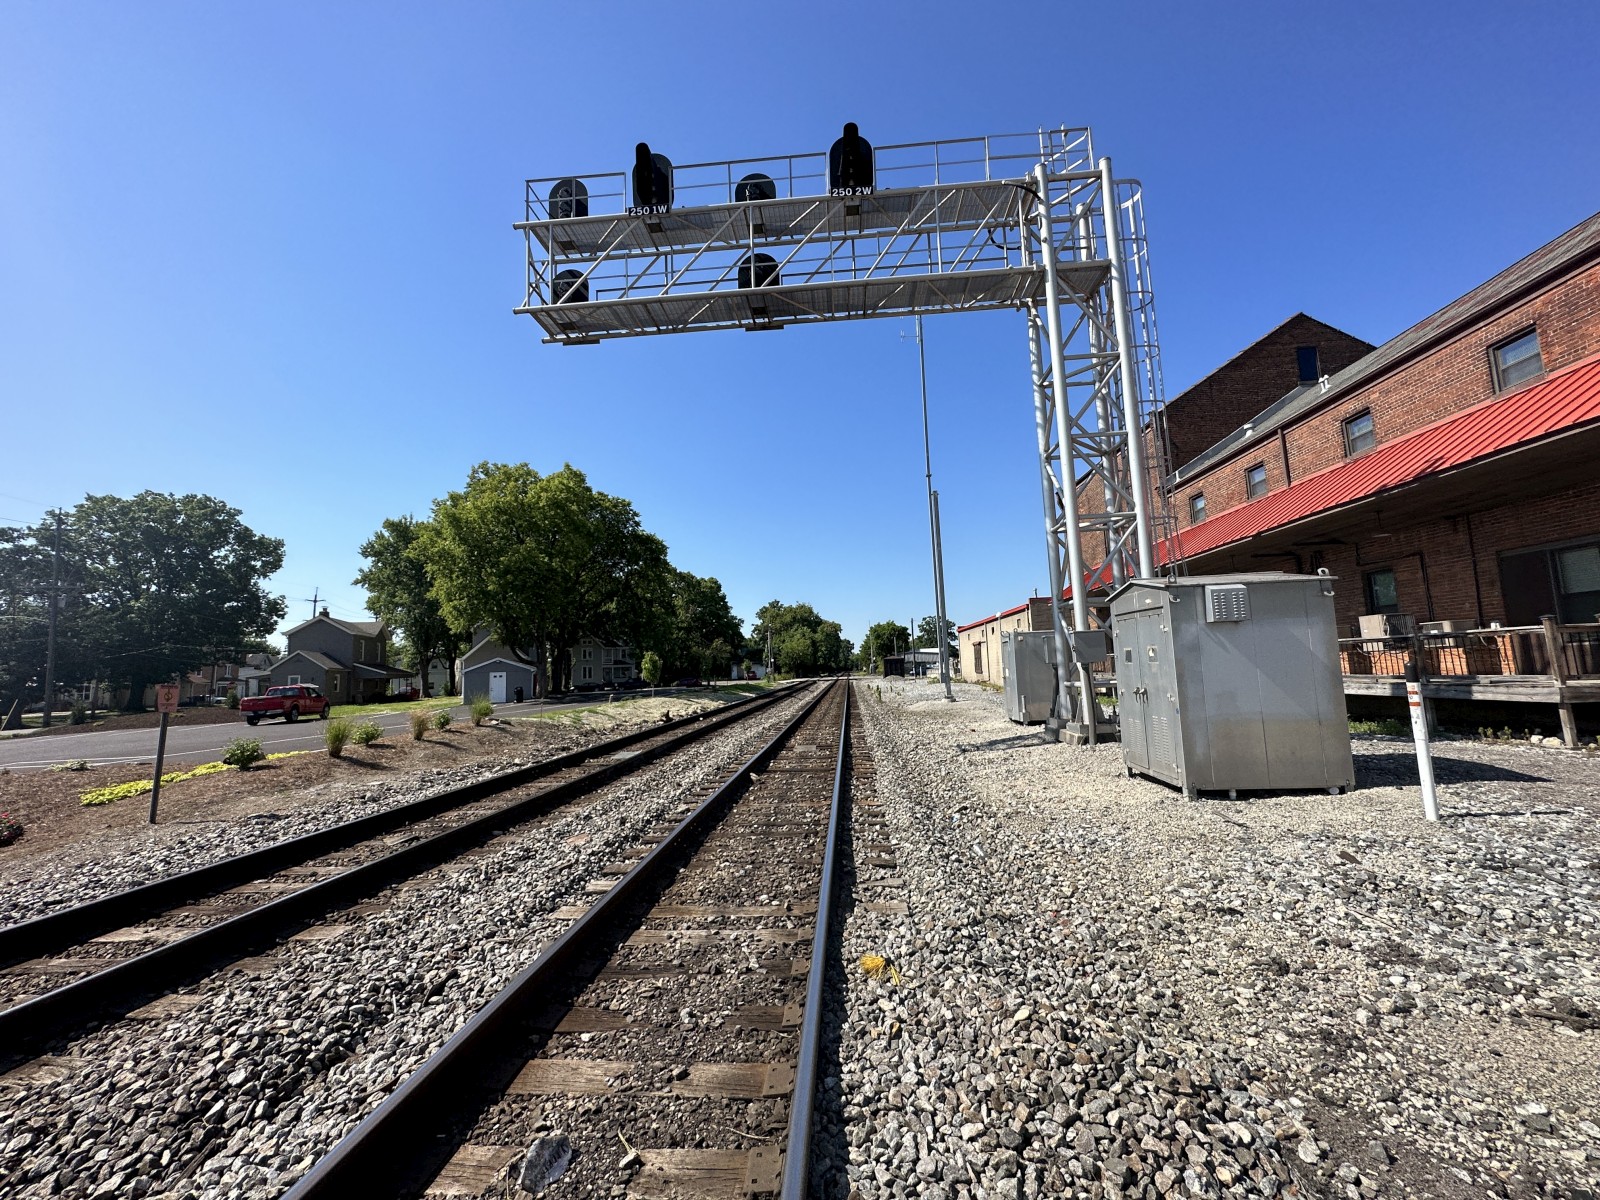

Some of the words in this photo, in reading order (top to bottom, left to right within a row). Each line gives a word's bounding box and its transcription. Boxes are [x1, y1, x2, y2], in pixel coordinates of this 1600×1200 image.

[832, 187, 853, 197] 250
[855, 186, 872, 196] 2W
[630, 206, 650, 216] 250
[652, 204, 667, 214] 1W
